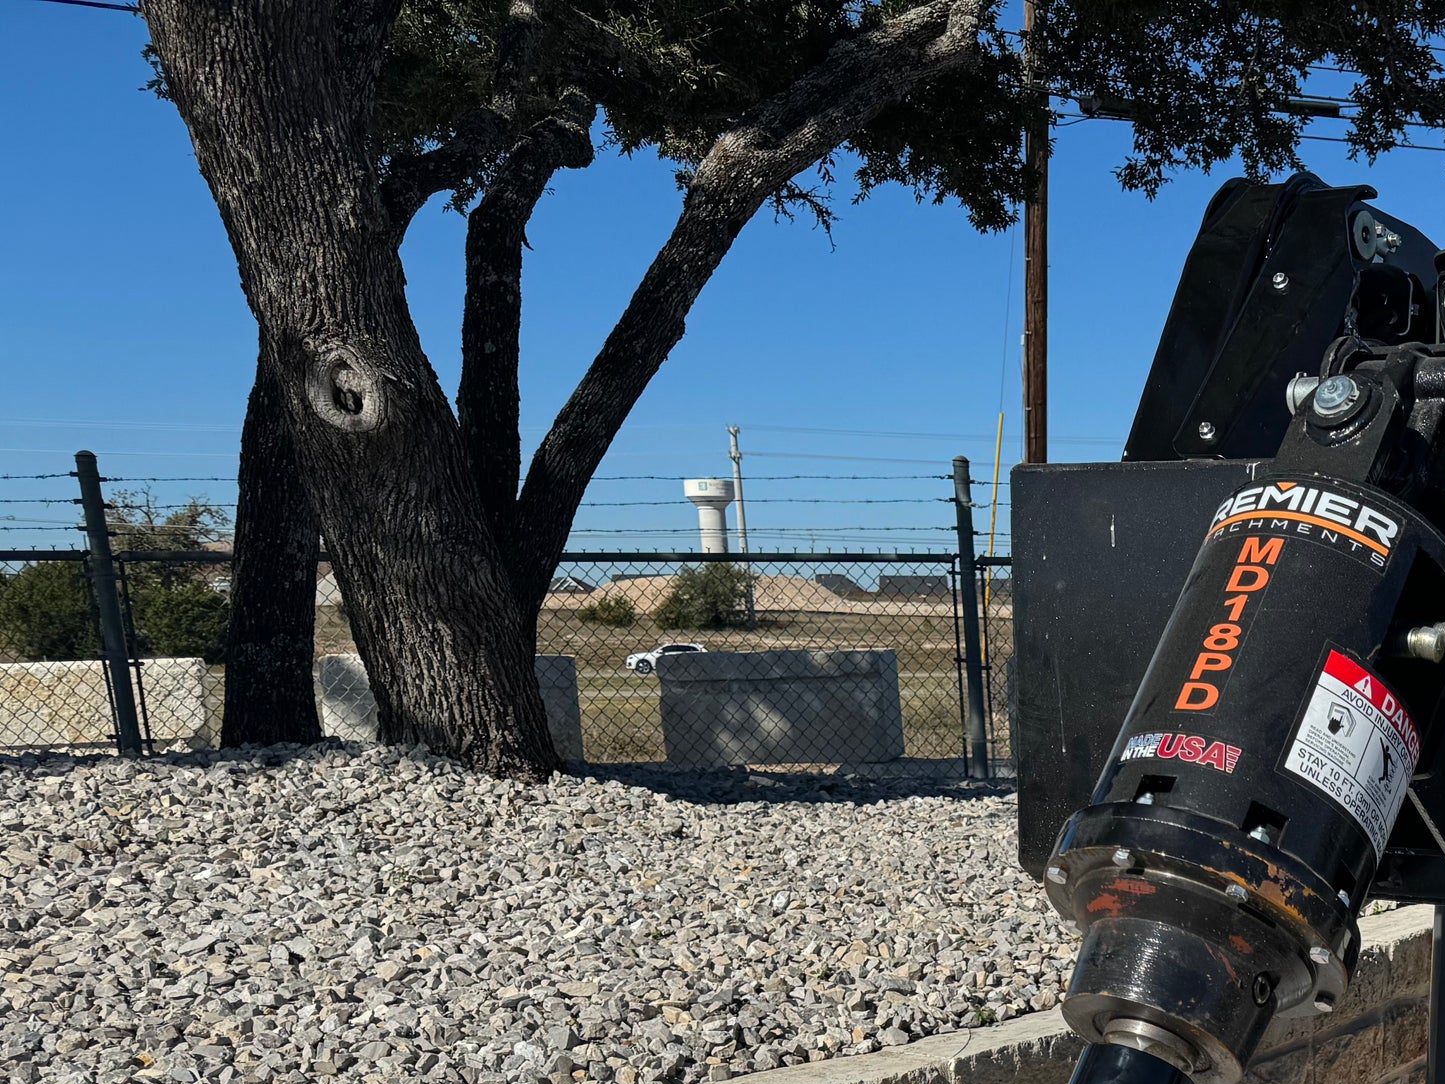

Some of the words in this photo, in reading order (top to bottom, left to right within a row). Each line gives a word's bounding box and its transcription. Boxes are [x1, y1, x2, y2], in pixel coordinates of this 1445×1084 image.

[1209, 485, 1398, 548] REMIER
[1213, 518, 1386, 567] ACHMENTS
[1174, 536, 1285, 711] MD18PD
[1127, 733, 1163, 750] MADE
[1341, 689, 1374, 717] AVOID
[1374, 713, 1402, 748] INJURY
[1131, 745, 1158, 759] THE
[1156, 733, 1226, 772] USA
[1298, 748, 1327, 770] STAY
[1329, 767, 1341, 782] 10
[1341, 776, 1355, 795] FT.
[1354, 790, 1371, 814] (3m)
[1299, 762, 1343, 798] UNLESS
[1343, 794, 1379, 843] OPERATING
